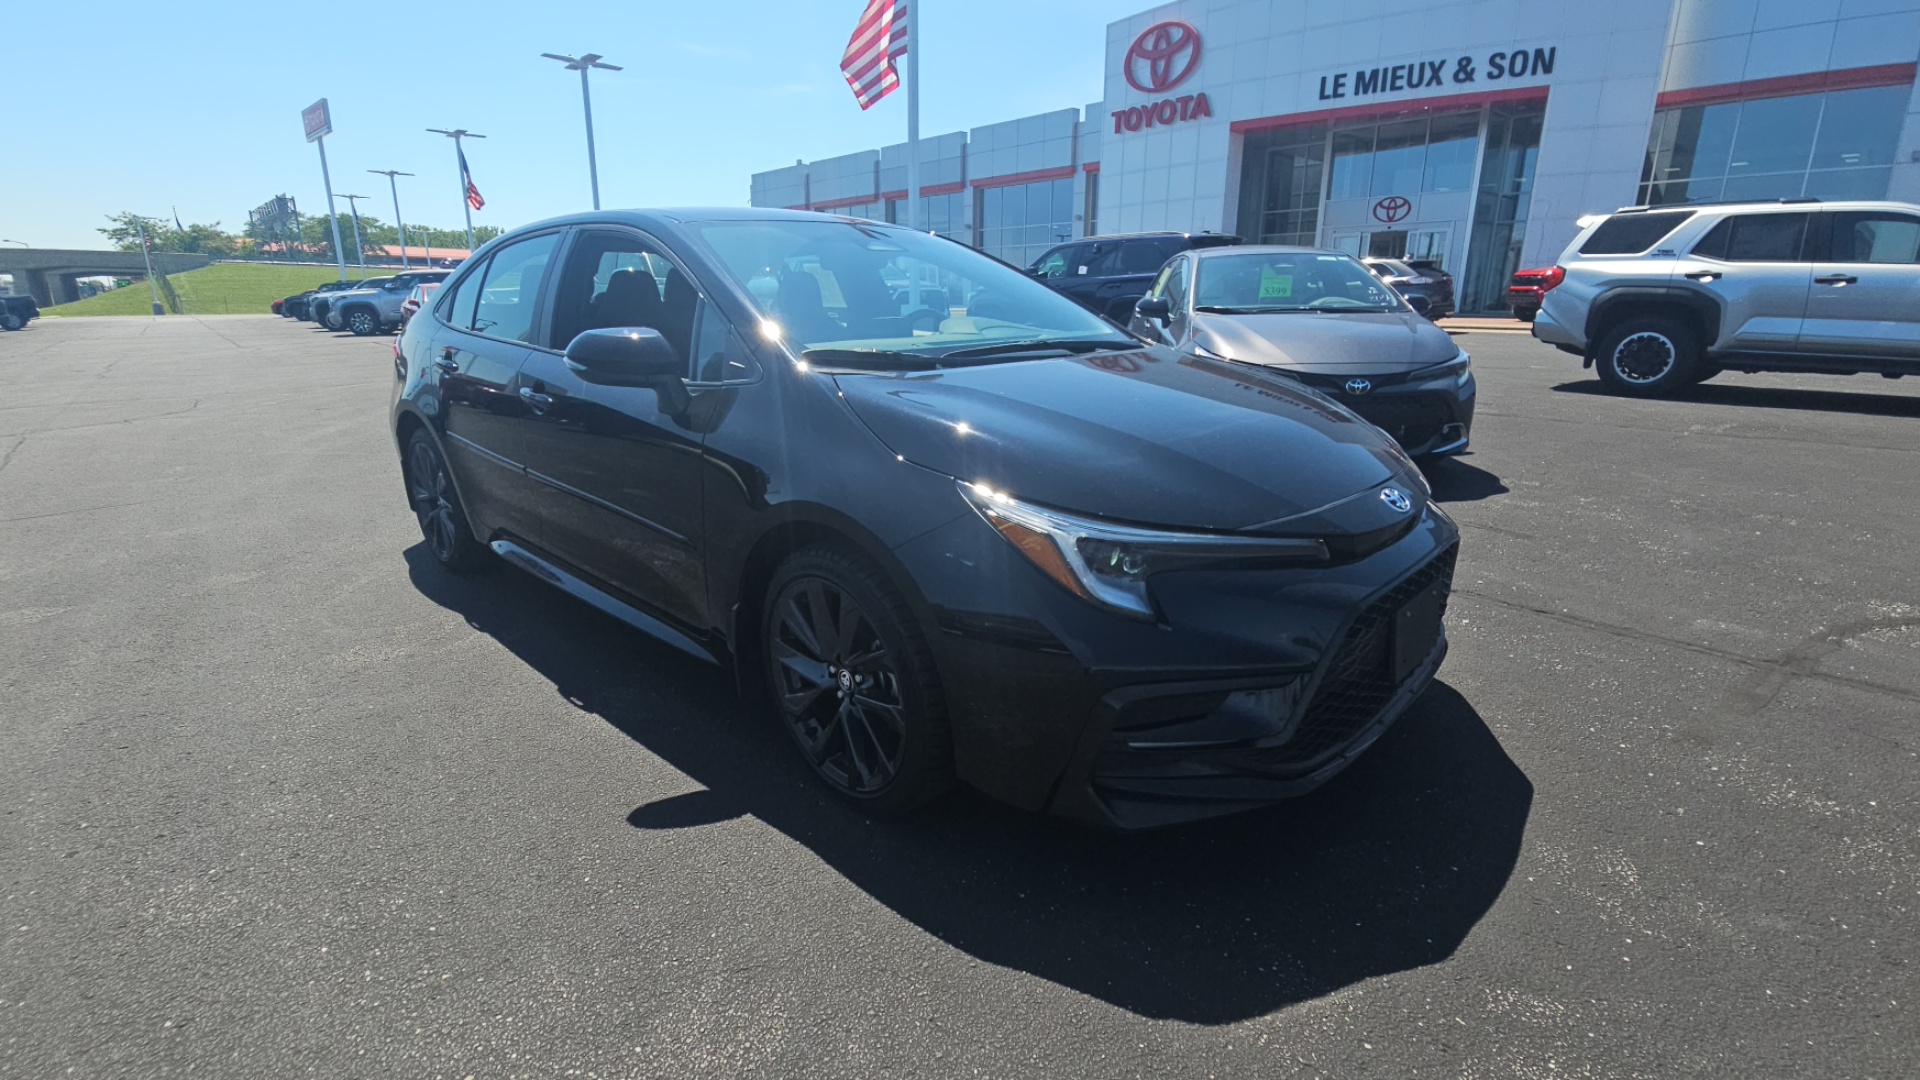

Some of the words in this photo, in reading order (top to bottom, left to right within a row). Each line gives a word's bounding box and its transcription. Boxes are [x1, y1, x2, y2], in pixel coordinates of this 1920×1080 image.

[1319, 73, 1347, 100] LE
[1354, 59, 1447, 96] MIEUX
[1453, 56, 1476, 83] &
[1487, 46, 1556, 80] SON
[1111, 92, 1212, 135] TOYOTA
